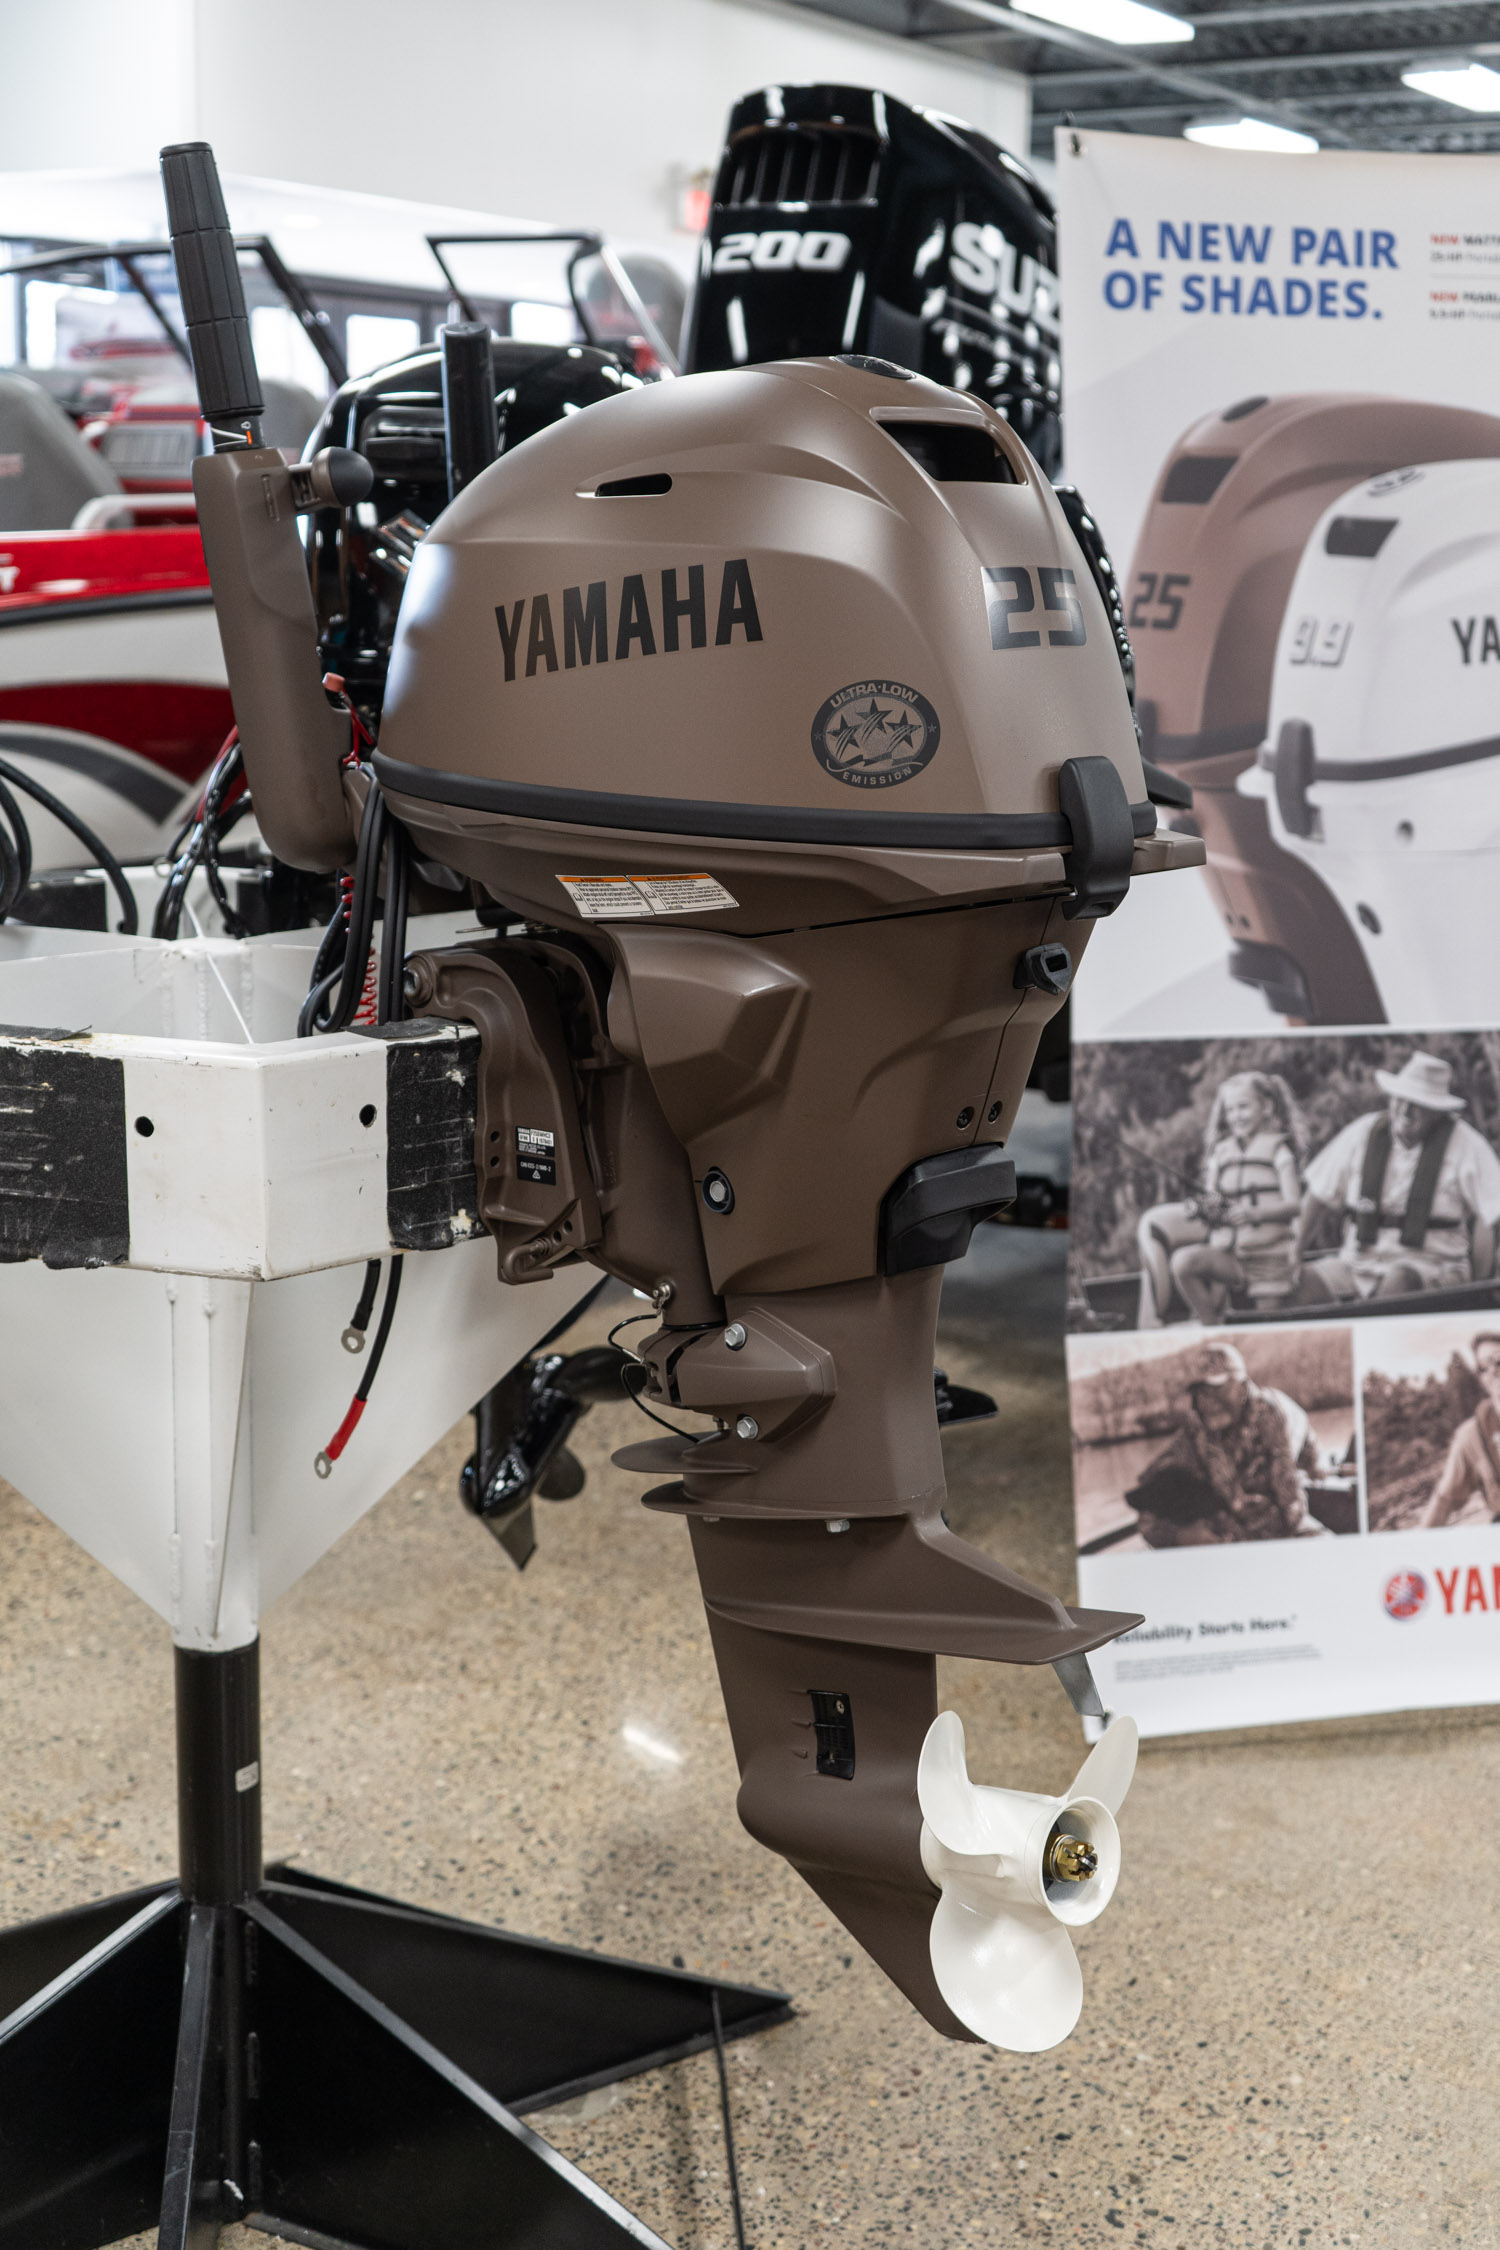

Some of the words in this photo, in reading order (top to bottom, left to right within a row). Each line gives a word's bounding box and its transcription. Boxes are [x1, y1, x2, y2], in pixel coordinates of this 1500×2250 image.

[712, 231, 852, 272] 200
[1105, 218, 1139, 258] A
[1157, 221, 1272, 264] NEW
[1291, 227, 1399, 269] PAIR
[1103, 271, 1163, 311] OF
[1180, 274, 1382, 319] SHADES.
[495, 558, 764, 683] YAMAHA
[981, 566, 1087, 650] 25
[1129, 572, 1191, 630] 25
[842, 766, 913, 786] EMISSION
[1434, 1564, 1500, 1615] YA
